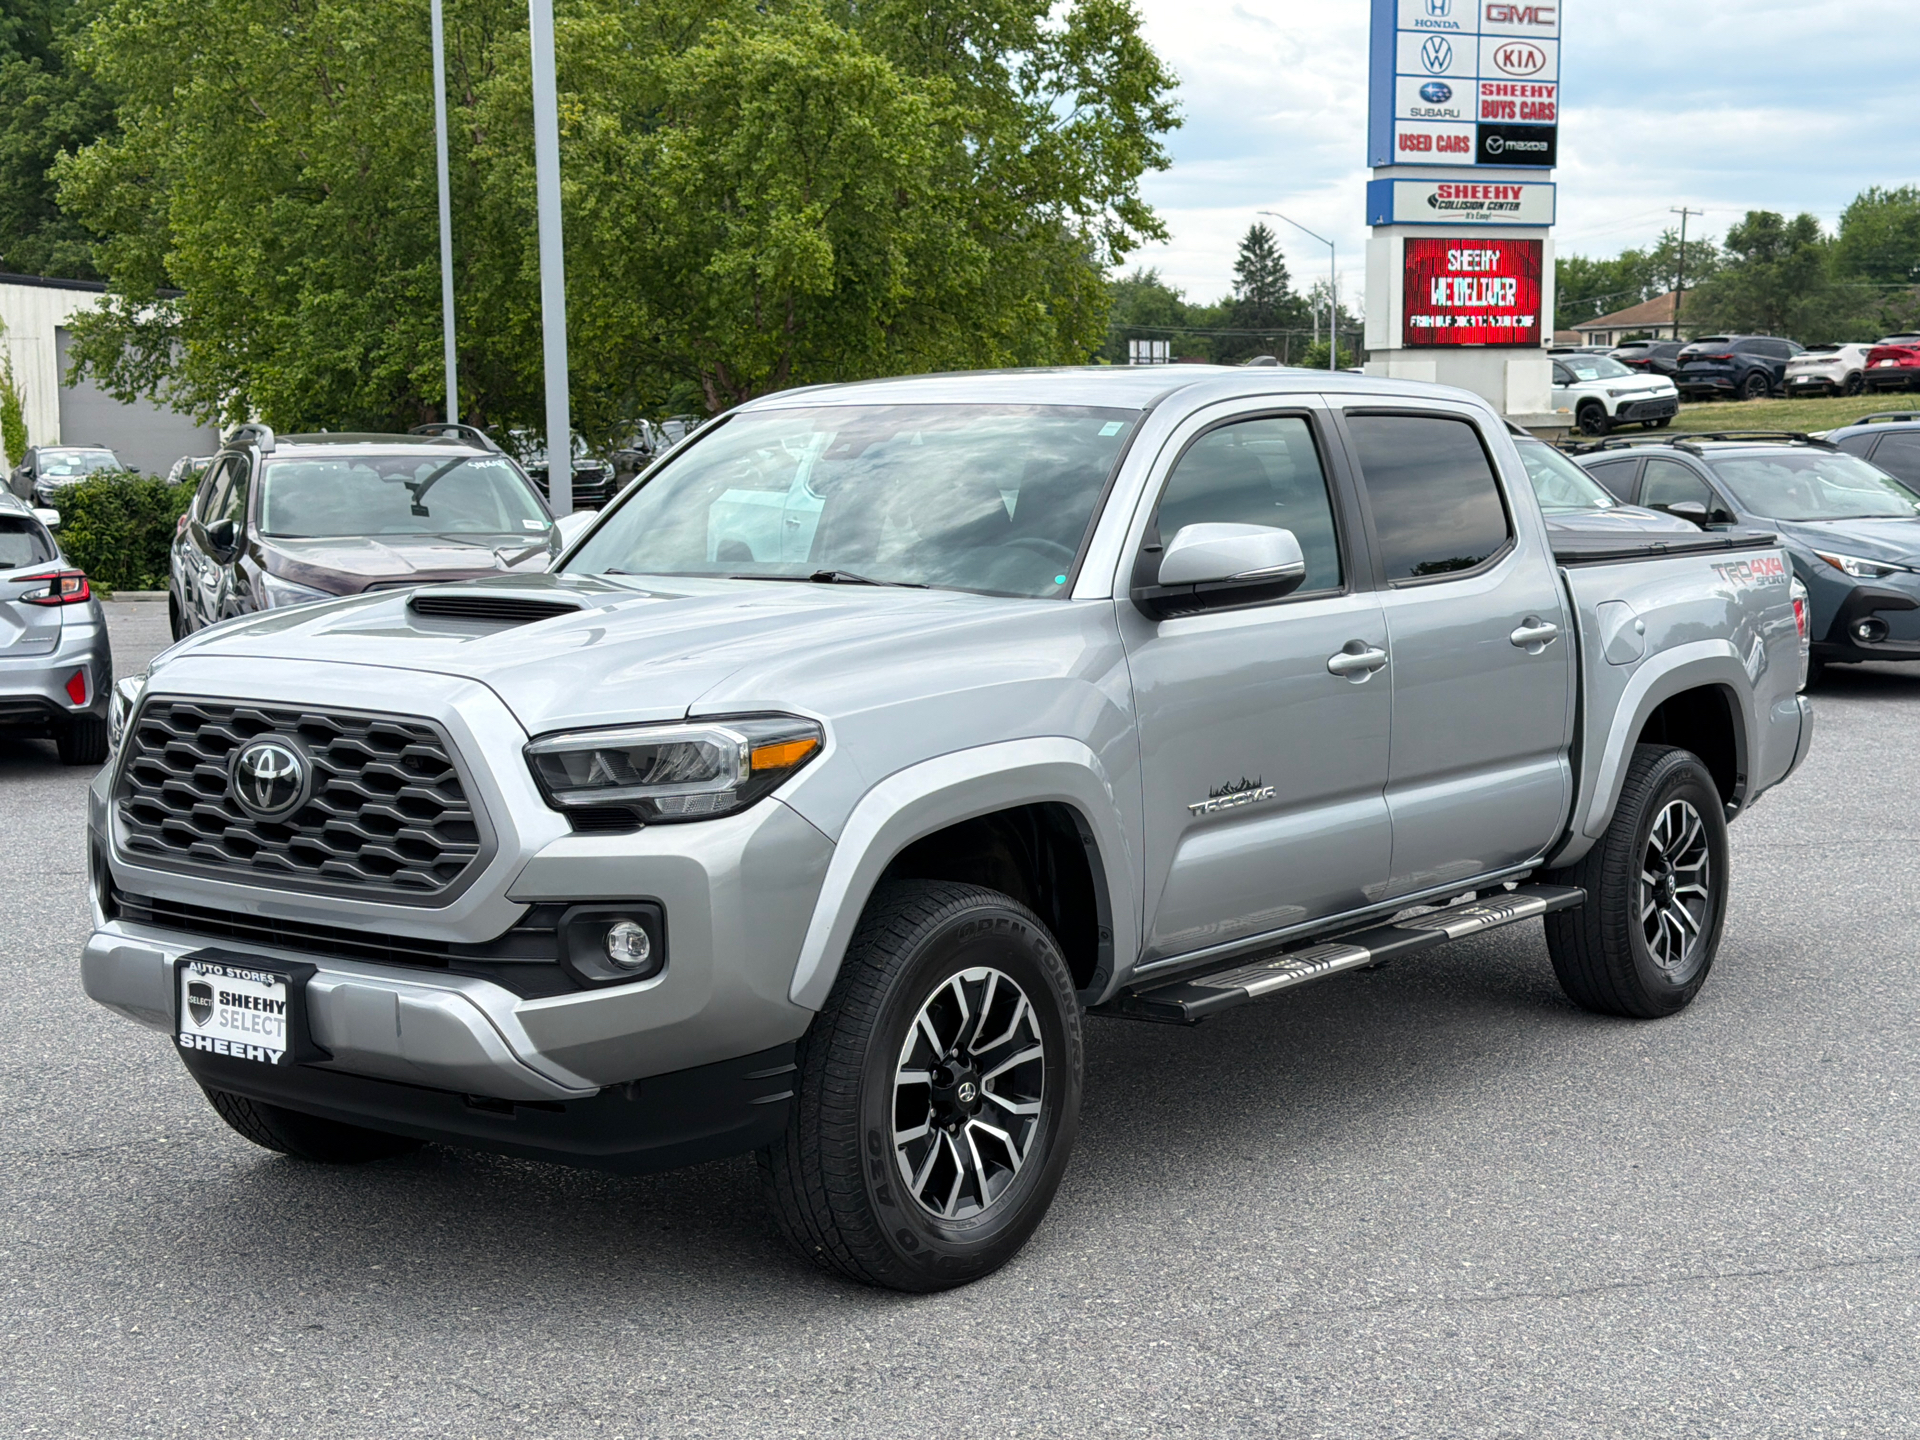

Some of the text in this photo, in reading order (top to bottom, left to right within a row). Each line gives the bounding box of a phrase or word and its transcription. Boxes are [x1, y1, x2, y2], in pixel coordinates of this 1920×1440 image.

[1414, 19, 1460, 30] HONDA
[1485, 4, 1555, 26] GMC
[1503, 49, 1537, 69] KIA
[1481, 83, 1555, 98] SHEEHY
[1410, 107, 1460, 118] SUBARU
[1481, 100, 1555, 120] BUYS CARS
[1399, 133, 1470, 153] USED CARS
[1505, 140, 1548, 151] mazda
[1437, 184, 1523, 200] SHEEHY
[1437, 200, 1521, 211] COLLISION CENTER
[1447, 249, 1500, 271] SHEEHY
[1710, 560, 1755, 587] TRD
[1756, 574, 1785, 586] SPORT
[1187, 786, 1277, 817] TACOMA
[189, 961, 275, 984] AUTO STORES
[189, 995, 212, 1007] SELECT
[219, 991, 286, 1015] SHEEHY
[219, 1008, 285, 1037] SELECT
[179, 1033, 284, 1065] SHEEHY
